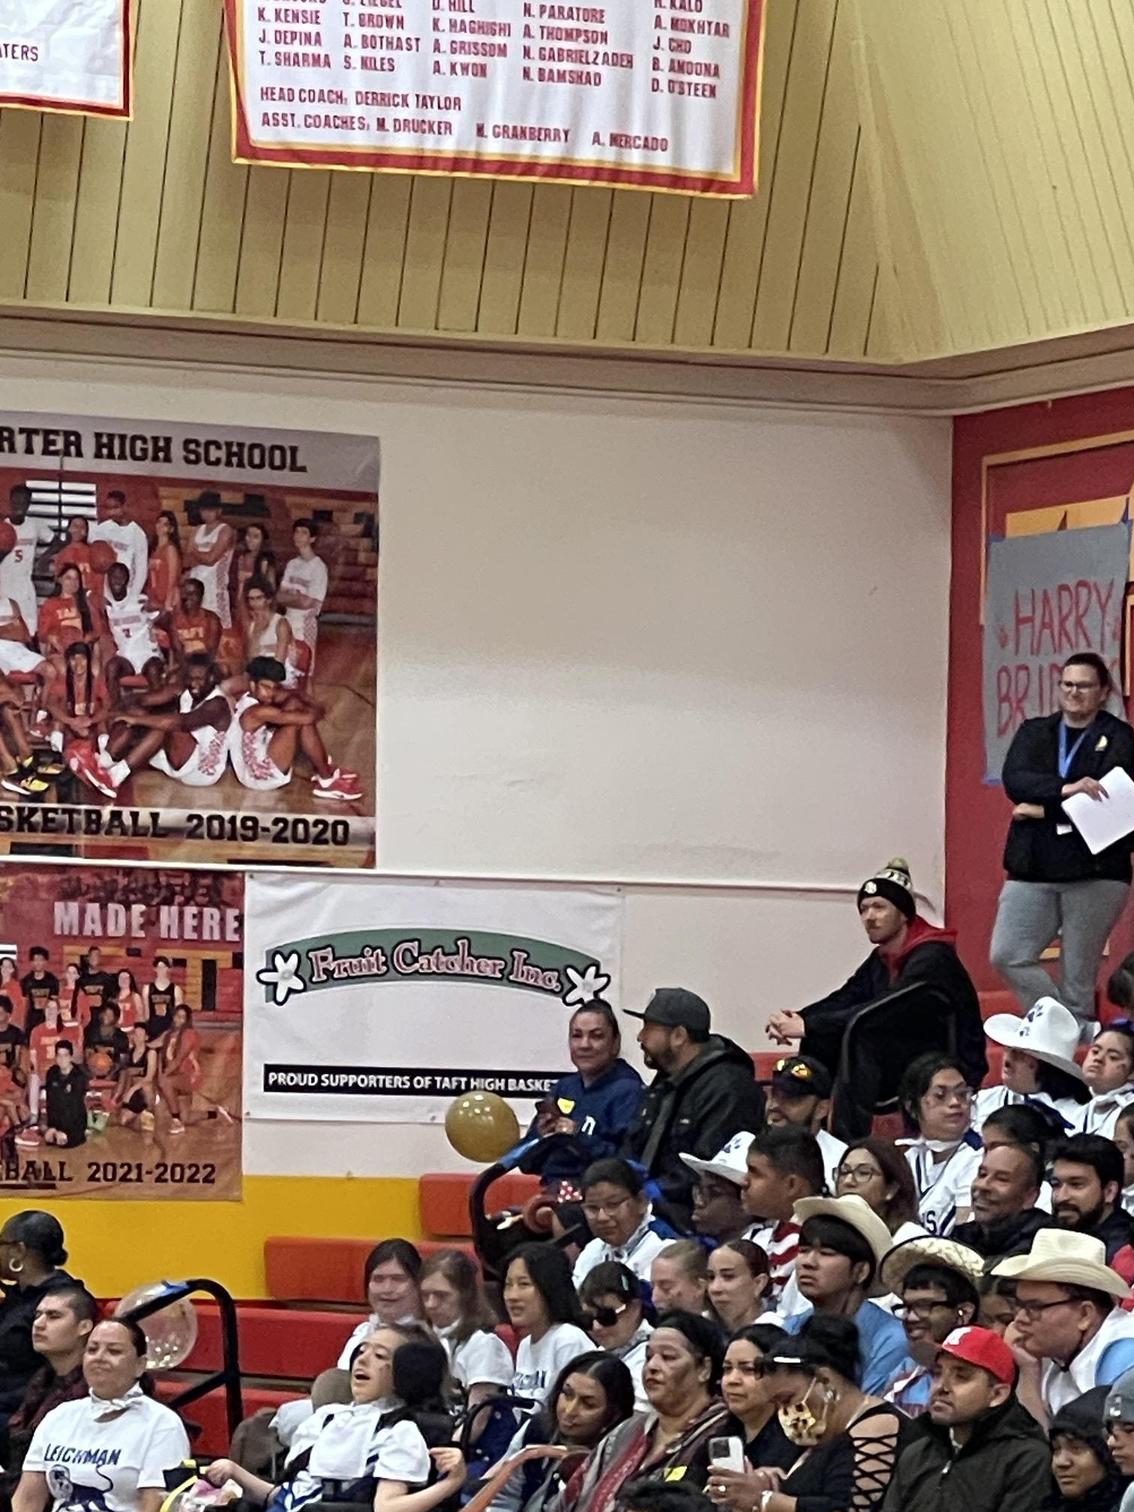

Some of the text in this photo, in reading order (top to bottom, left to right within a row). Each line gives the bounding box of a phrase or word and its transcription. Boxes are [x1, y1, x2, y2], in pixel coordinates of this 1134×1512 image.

[257, 7, 321, 25] K. KENSIE
[343, 12, 404, 30] T. BROWN
[539, 4, 605, 24] PARATORE
[654, 14, 667, 30] A.
[432, 17, 445, 32] K.
[523, 24, 608, 45] A. THOMPSON
[258, 28, 322, 46] J. DEPINA
[343, 33, 421, 52] A. BOTHAST
[653, 35, 664, 51] J.
[433, 38, 507, 58] A. GRISSOM
[259, 50, 331, 69] T. SHARMA
[343, 54, 357, 70] S.
[433, 60, 487, 78] A. KWON
[261, 86, 295, 102] HEAD
[355, 91, 409, 108] DERRICK
[415, 93, 461, 111] TAYLOR
[262, 112, 300, 128] ASST.
[393, 118, 452, 135] DRUCKER
[492, 124, 570, 143] GRANBERRY
[592, 131, 605, 147] A.
[609, 132, 668, 152] MERCADO
[94, 432, 172, 464] HIGH
[183, 437, 307, 473] SCHOOL
[1013, 577, 1114, 656] HARRY
[186, 813, 350, 846] 2019-2020
[54, 901, 241, 942] MADE HERE
[308, 938, 563, 992] Fruit Catcher Inc.
[268, 1072, 318, 1086] PROUD
[321, 1073, 410, 1089] SUPPORTERS
[413, 1075, 432, 1089] OF
[435, 1076, 467, 1090] TAFT
[470, 1078, 505, 1091] HIGH
[0, 1160, 216, 1184] BALL 2021-2022
[44, 1443, 122, 1466] LEICHMAN
